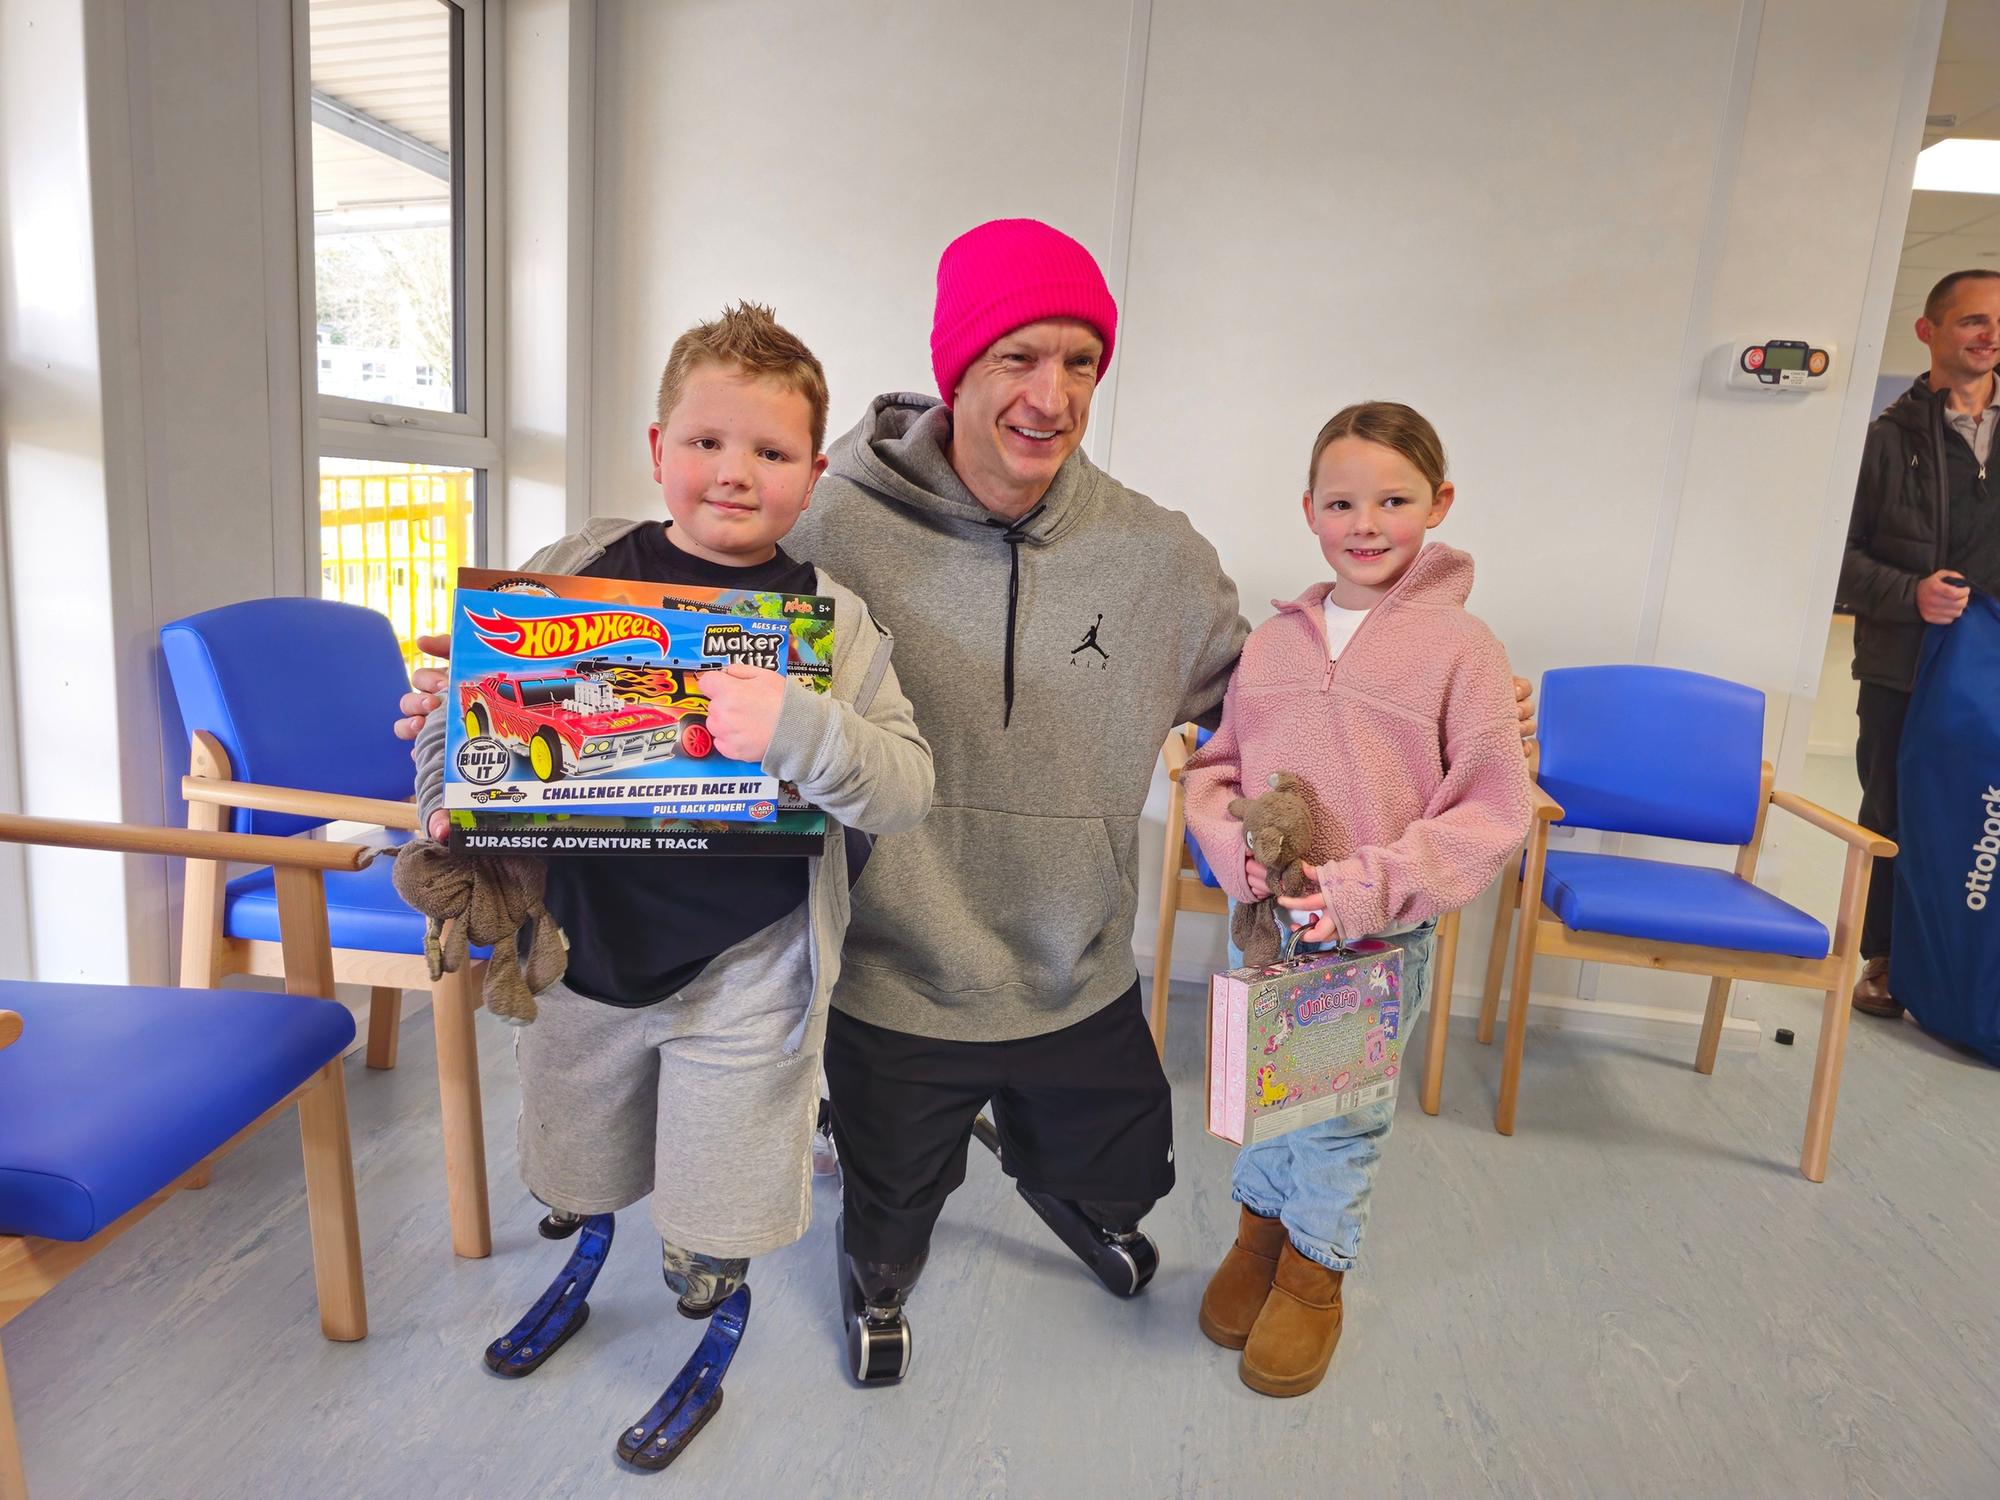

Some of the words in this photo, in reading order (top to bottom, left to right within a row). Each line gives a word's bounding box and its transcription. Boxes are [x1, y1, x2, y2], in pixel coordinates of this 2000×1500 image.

[818, 604, 831, 613] 5+
[708, 626, 740, 634] MOTOR
[751, 622, 771, 630] AGES
[771, 623, 788, 632] 6-12
[706, 635, 780, 653] Maker
[733, 652, 776, 669] Kitz
[460, 752, 507, 766] BUILD
[477, 766, 493, 779] IT
[542, 786, 626, 800] CHALLENGE
[628, 784, 698, 797] ACCEPTED
[701, 782, 736, 795] RACE
[739, 782, 762, 793] KIT
[653, 805, 678, 814] PULL
[680, 804, 707, 813] BACK
[708, 803, 745, 813] POWER!
[465, 836, 548, 848] JURASSIC
[552, 837, 652, 849] ADVENTURE
[655, 838, 709, 849] TRACK
[1965, 785, 2000, 911] ottobock
[1300, 988, 1358, 1021] Unicorn
